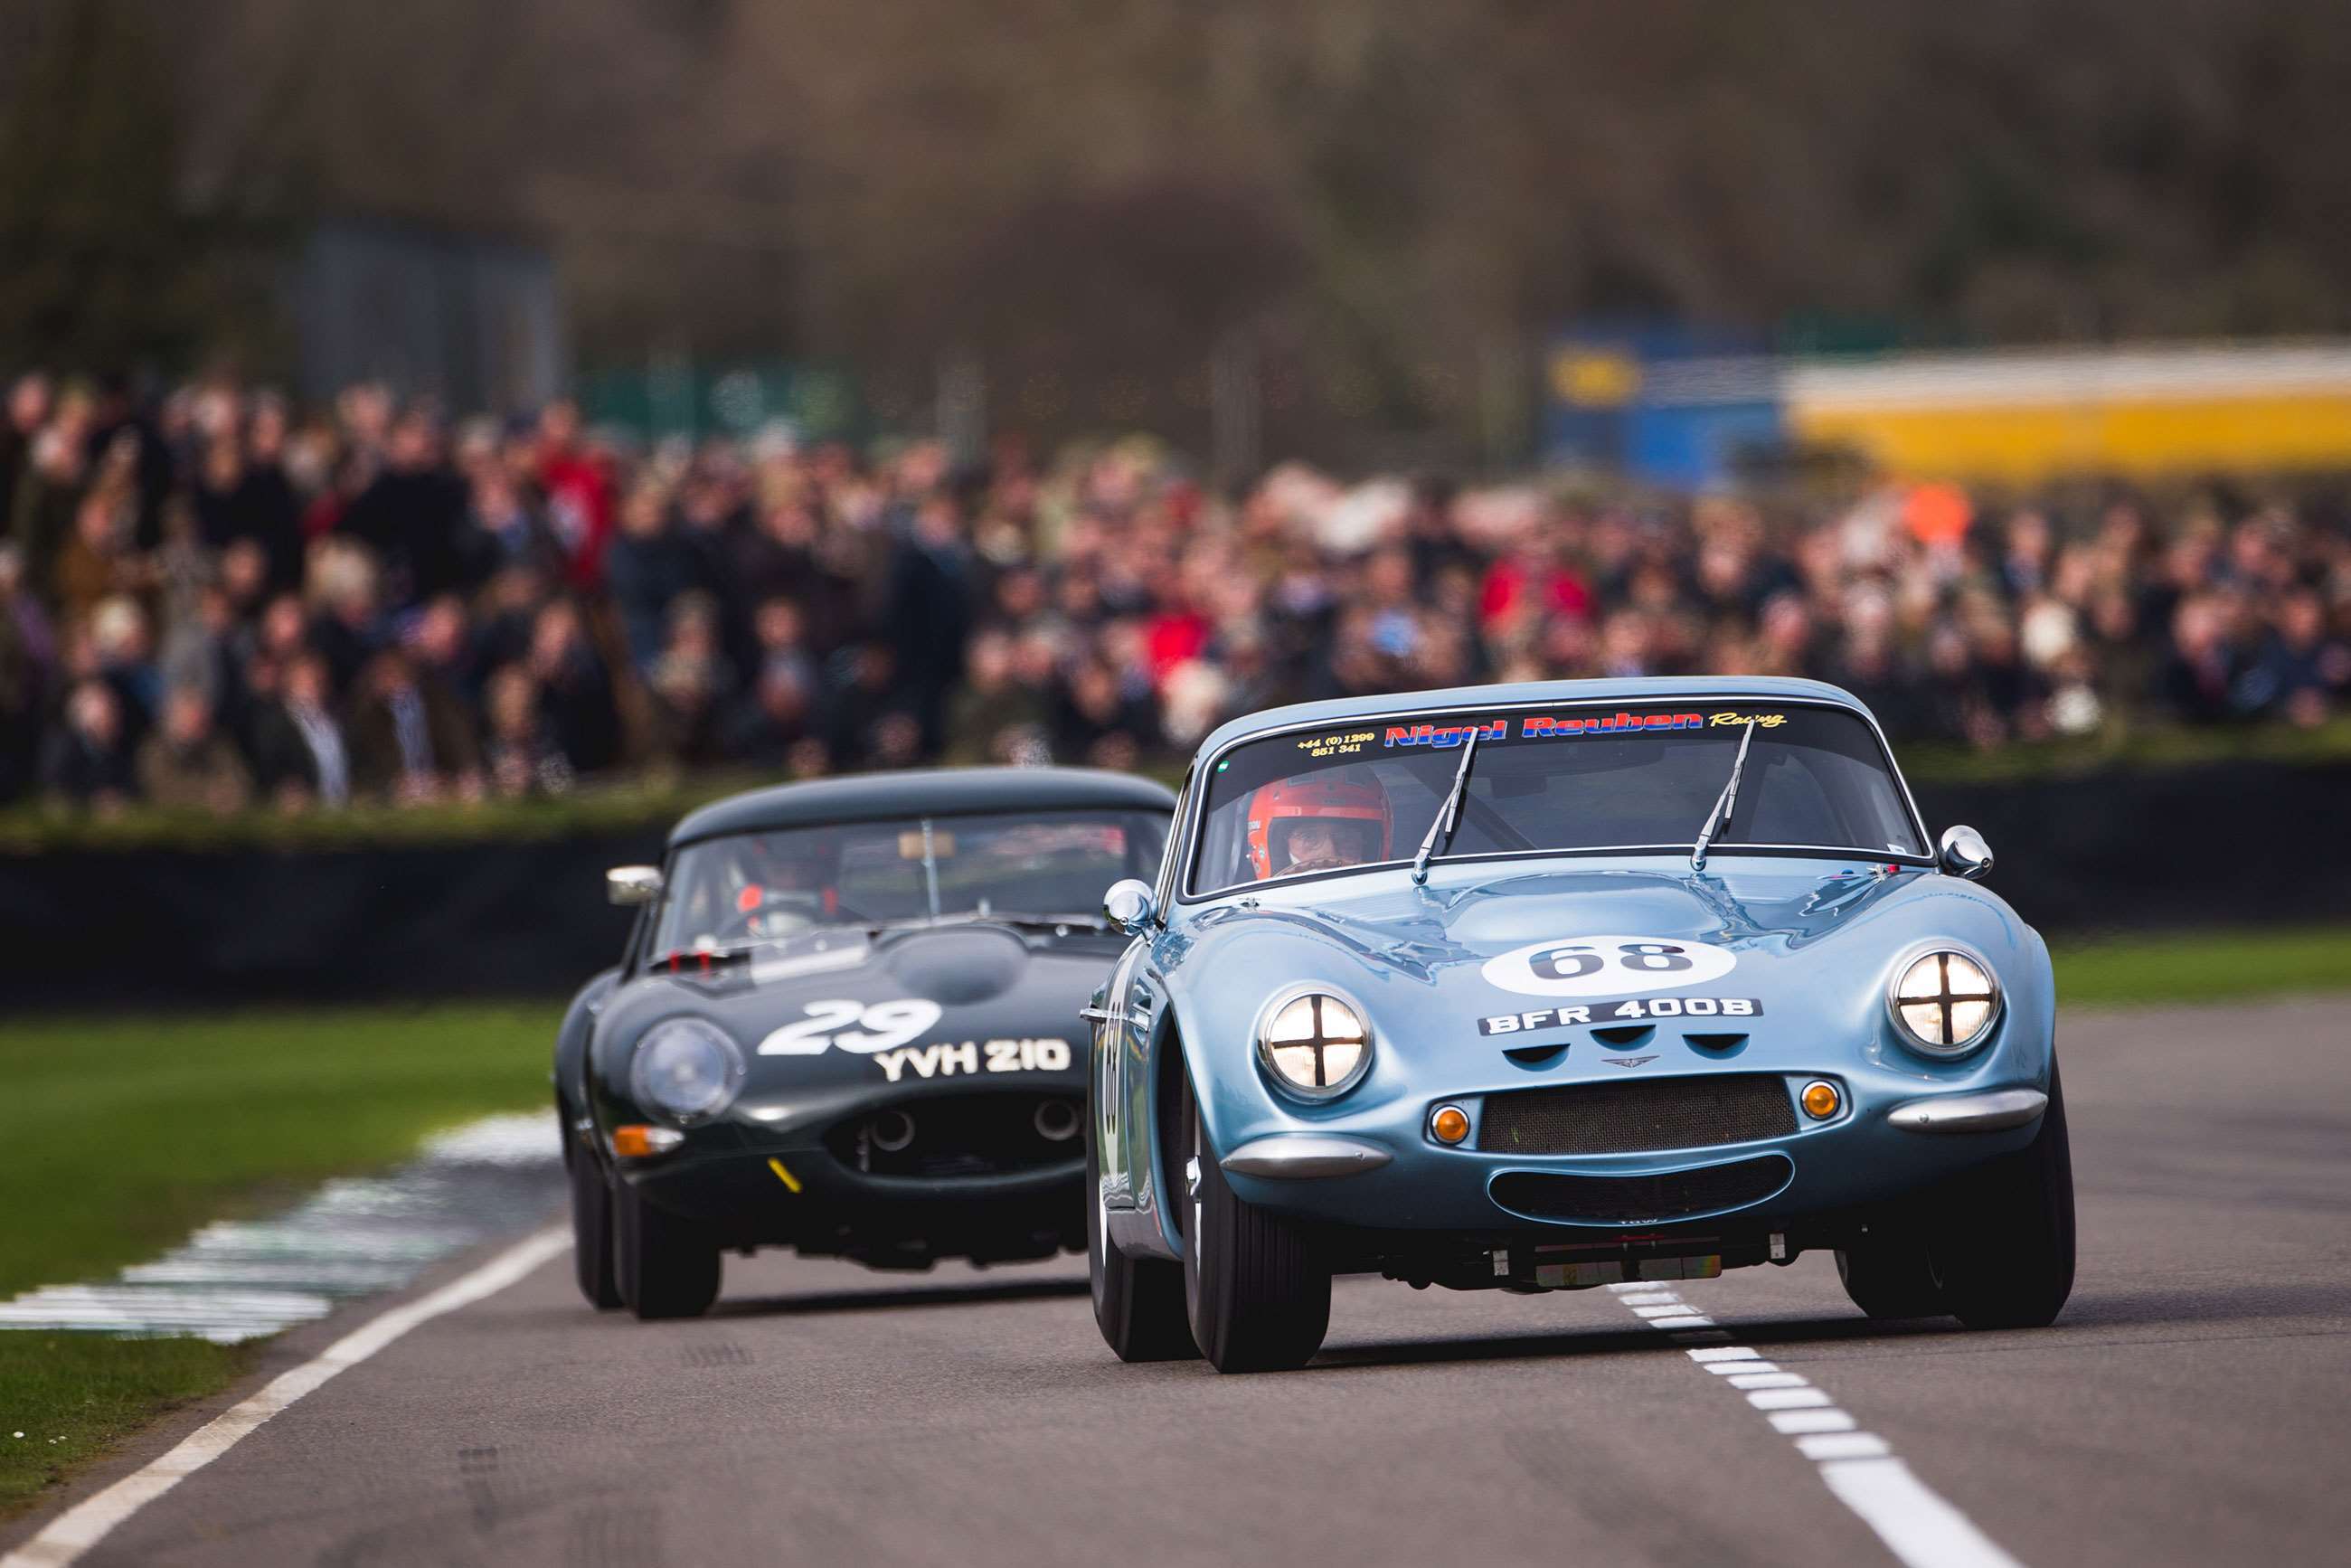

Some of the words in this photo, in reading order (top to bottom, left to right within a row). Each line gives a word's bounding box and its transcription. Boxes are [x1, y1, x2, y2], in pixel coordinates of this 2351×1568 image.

[1297, 738, 1321, 749] +44
[1383, 720, 1508, 749] Nigel
[1522, 713, 1704, 738] Reuben
[1708, 712, 1788, 728] Racing
[1310, 747, 1335, 757] 851
[1338, 743, 1361, 753] 341
[1528, 943, 1694, 980] 68
[757, 998, 942, 1055] 29
[1487, 1006, 1591, 1035] BFR
[1614, 998, 1755, 1019] 400B
[873, 1042, 977, 1082] YVH
[983, 1039, 1071, 1072] 210
